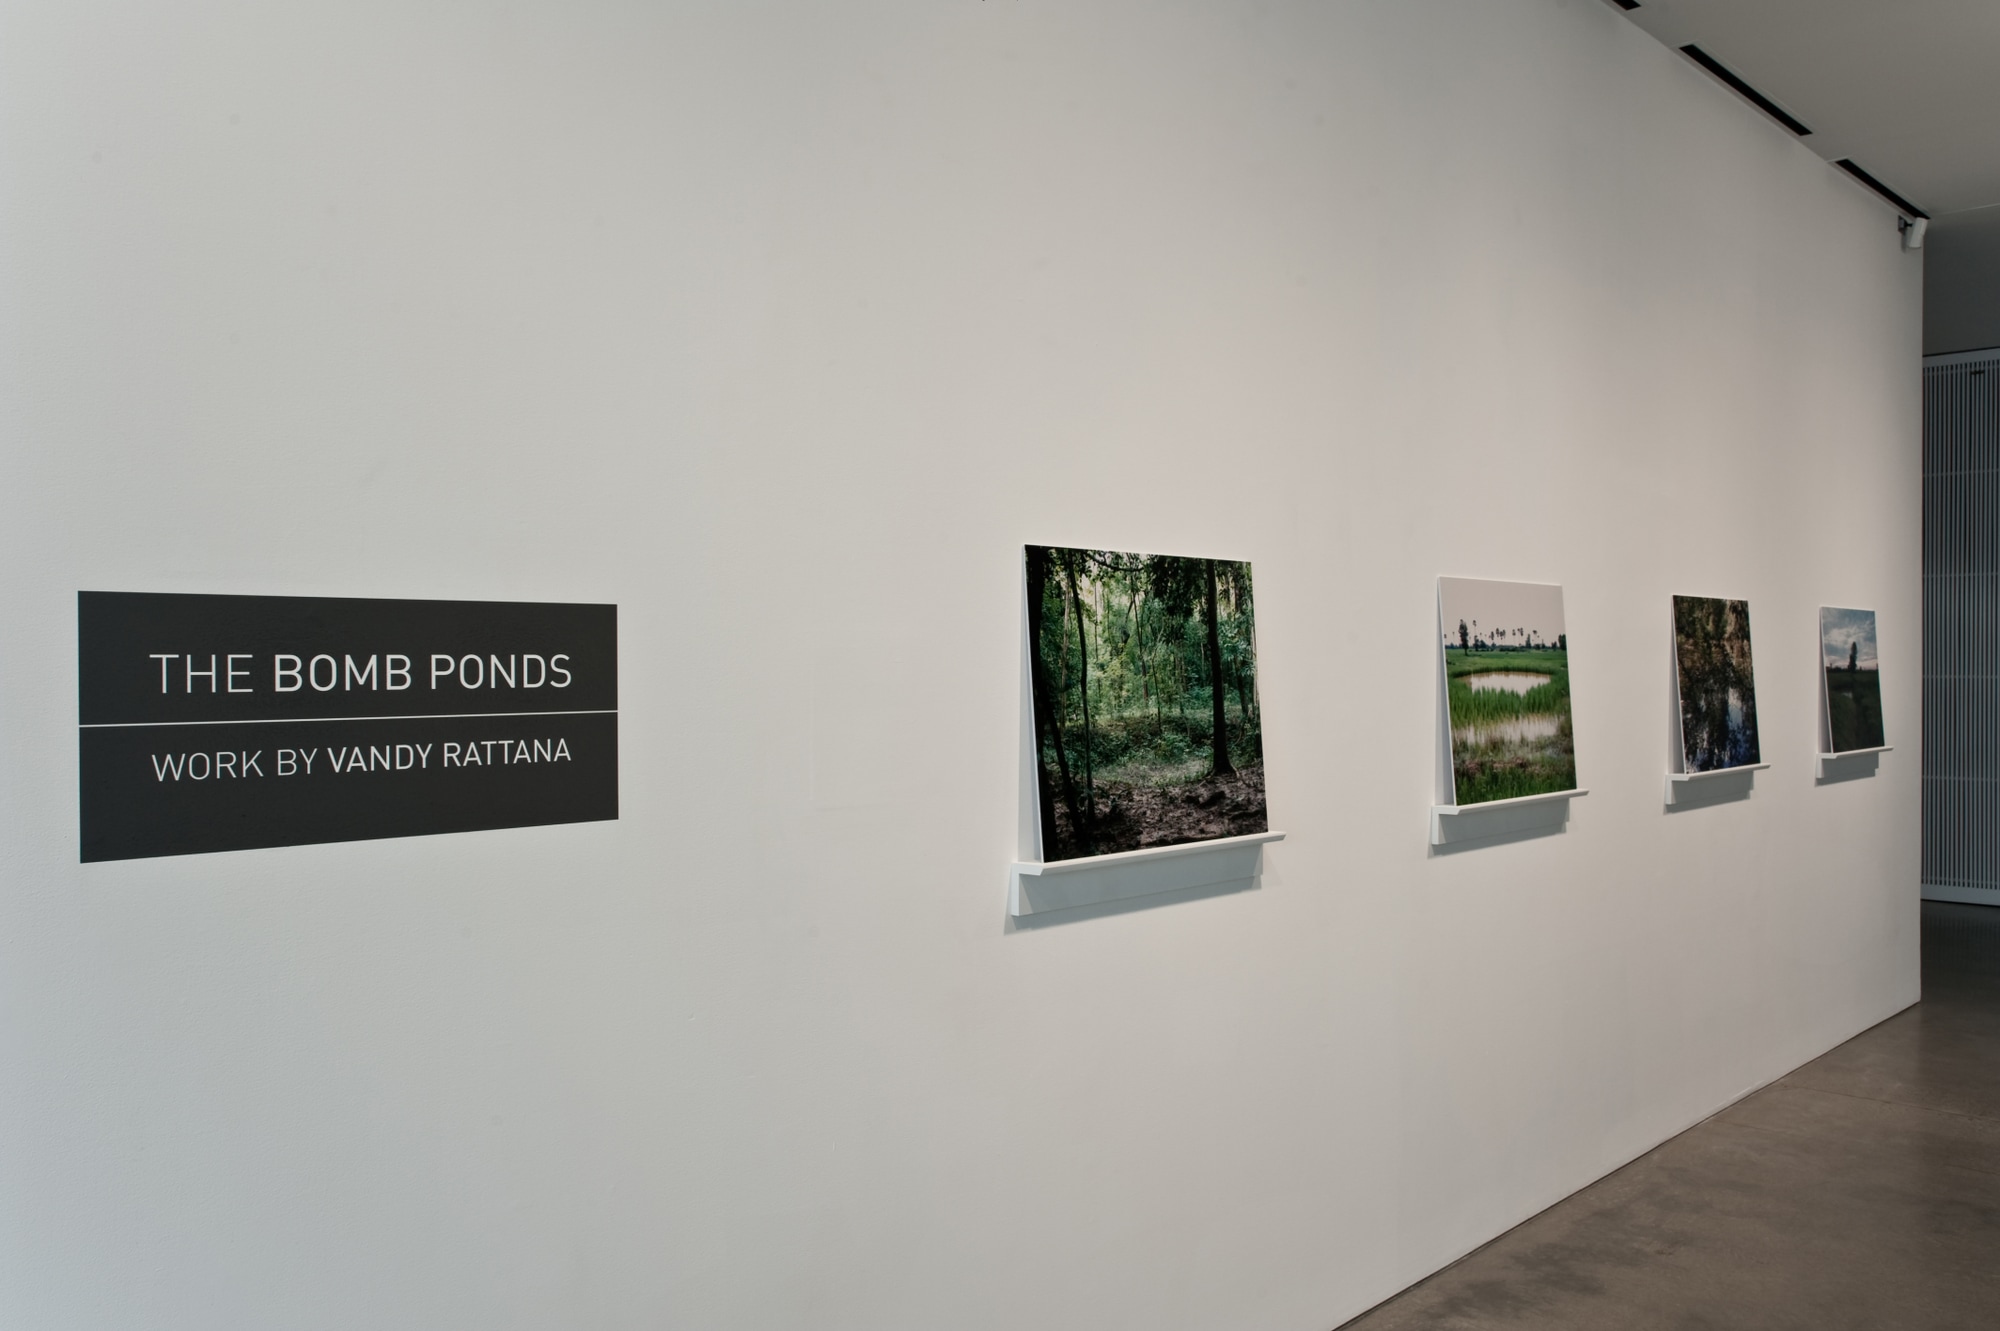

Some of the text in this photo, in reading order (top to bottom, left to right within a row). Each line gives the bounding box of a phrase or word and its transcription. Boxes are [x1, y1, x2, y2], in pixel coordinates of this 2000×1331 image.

[149, 653, 572, 694] THE BOMB PONDS
[151, 737, 572, 782] WORK BY VANDY RATTANA
